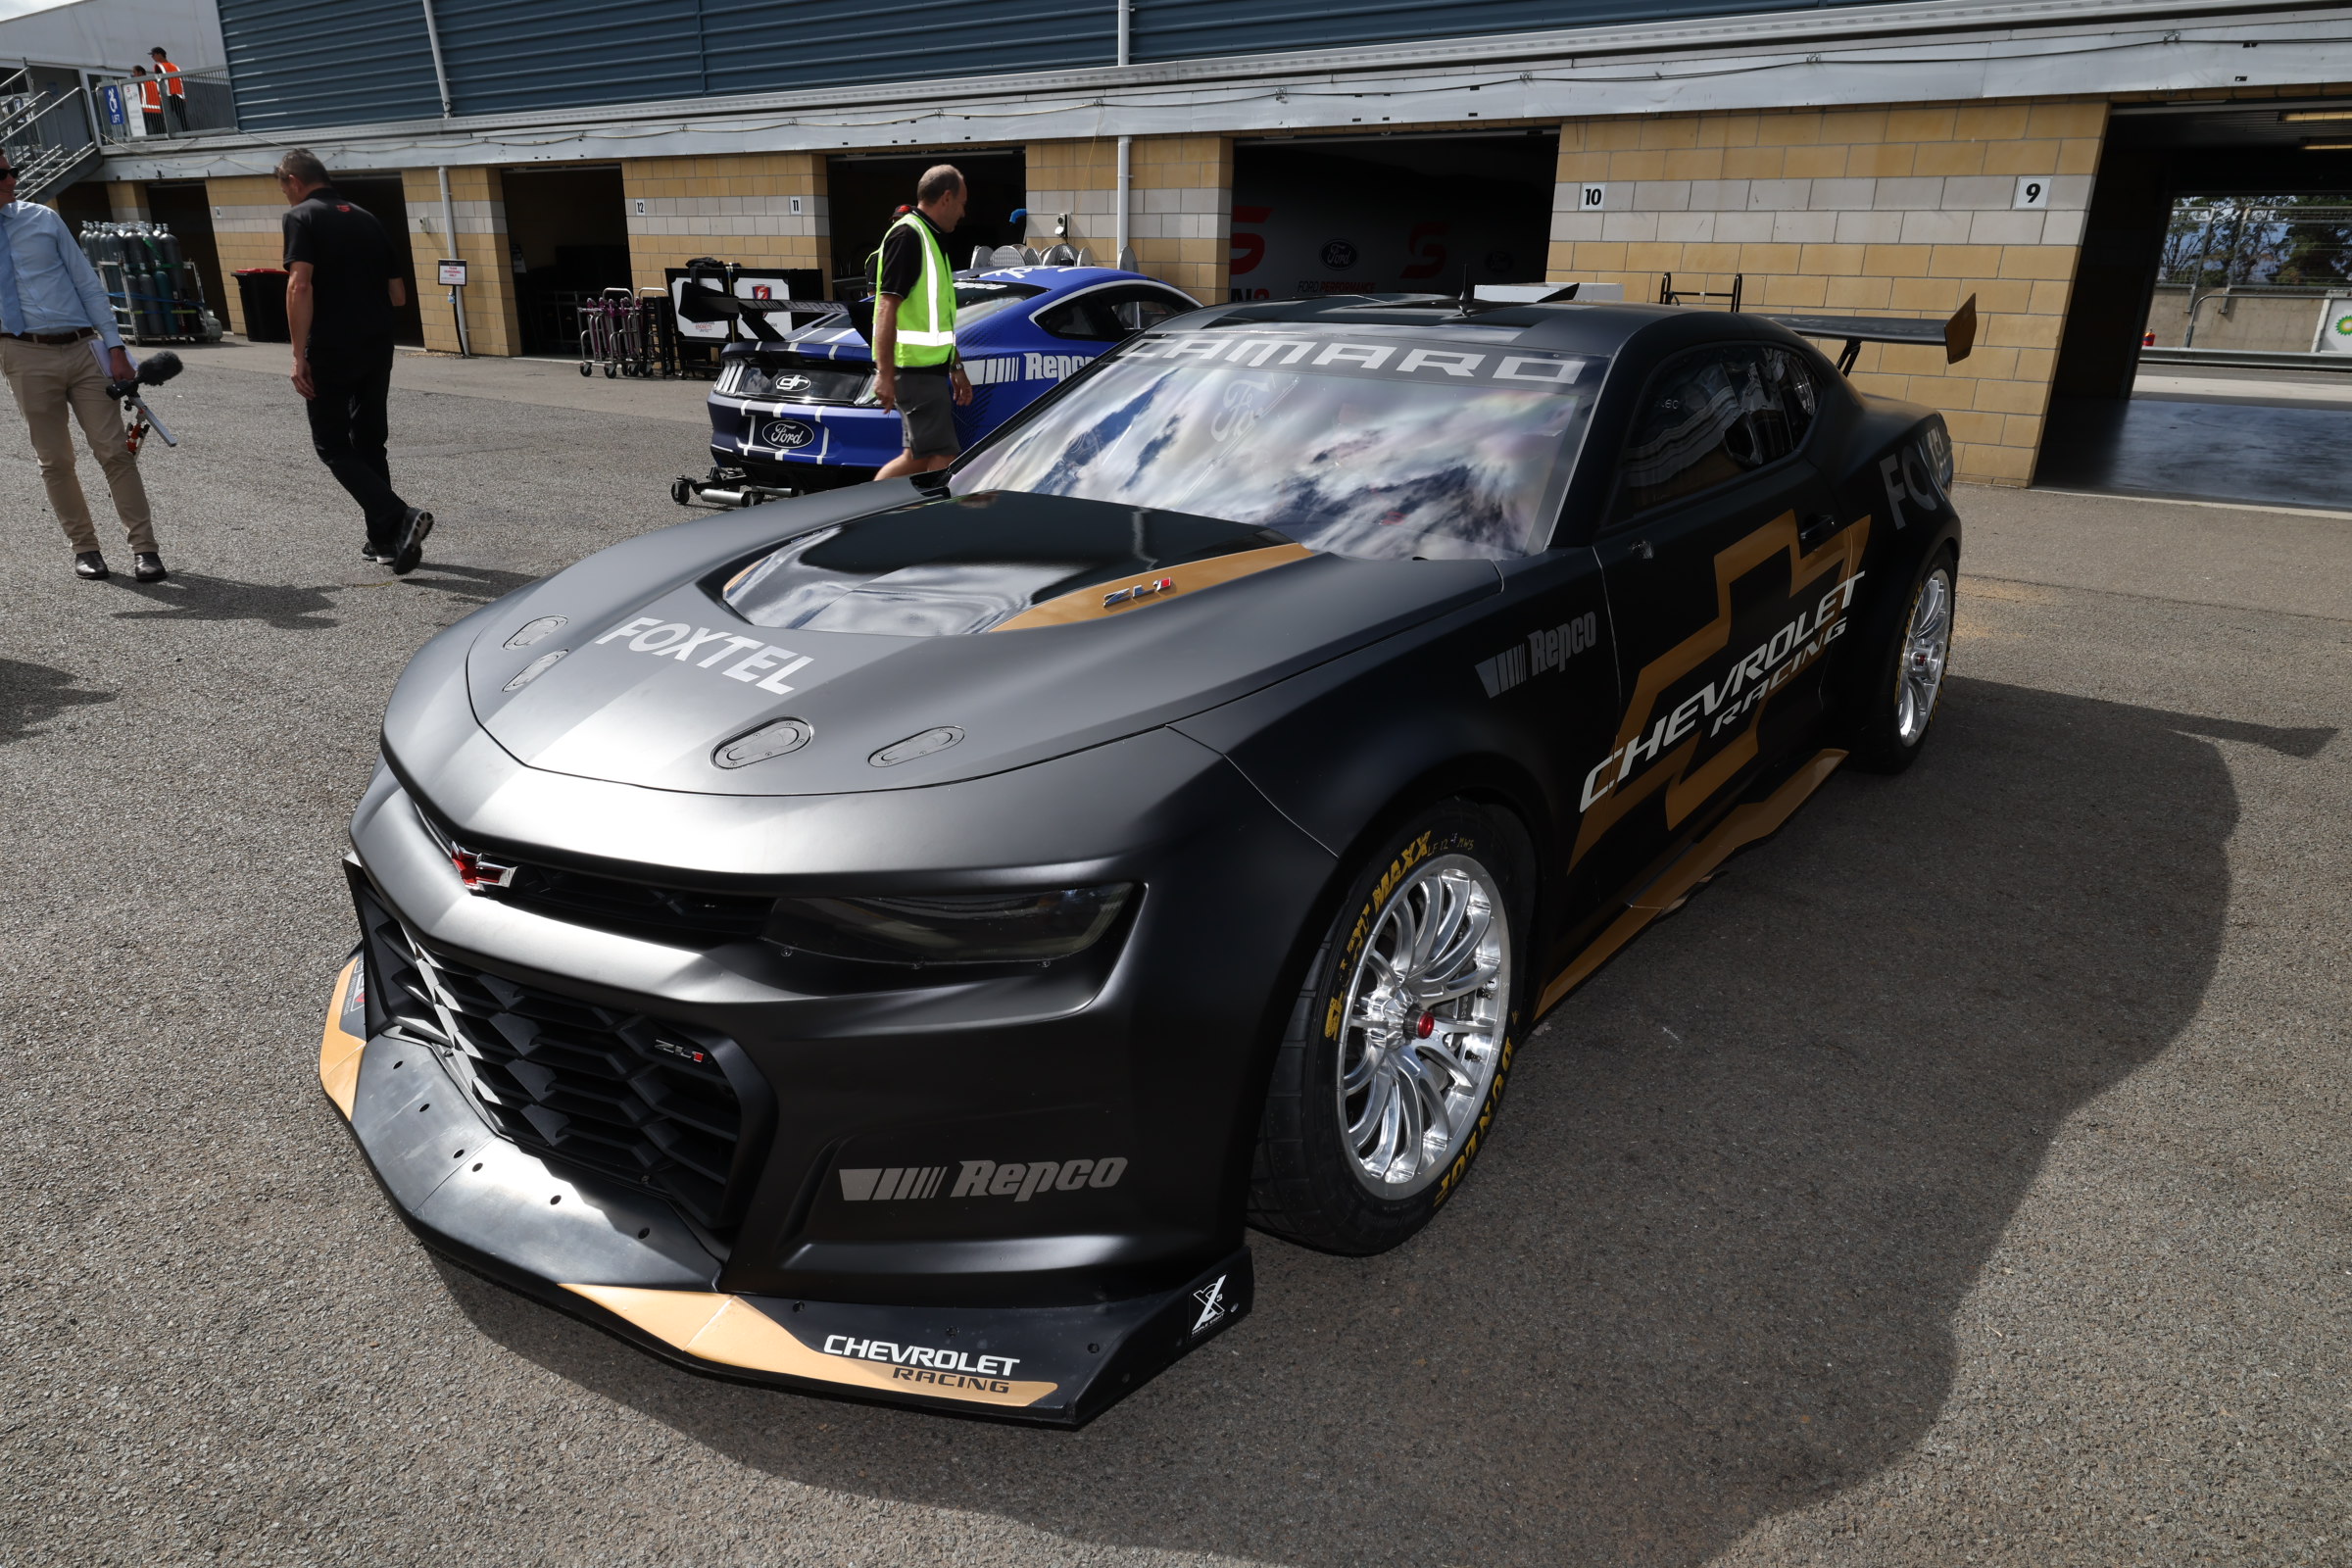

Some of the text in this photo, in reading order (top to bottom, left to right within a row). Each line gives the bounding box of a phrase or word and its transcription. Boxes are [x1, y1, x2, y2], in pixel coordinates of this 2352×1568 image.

[636, 202, 644, 213] 12
[792, 200, 800, 212] 11
[1585, 188, 1602, 206] 10
[2026, 183, 2041, 204] 9
[1326, 241, 1354, 265] Ford
[1319, 281, 1376, 293] PERFORMANCE
[1023, 353, 1096, 383] Repc
[1115, 337, 1587, 384] CAMARO
[769, 422, 805, 446] Ford
[594, 616, 815, 695] FOXTEL
[1527, 612, 1596, 676] Repco
[1579, 570, 1865, 812] CHEVROLET
[1710, 616, 1846, 738] RACING
[1372, 830, 1432, 914] MAXX
[1433, 1036, 1513, 1207] DUNLOP
[950, 1156, 1128, 1202] Repco
[823, 1334, 1021, 1376] CHEVROLET
[893, 1367, 1010, 1395] RACING
